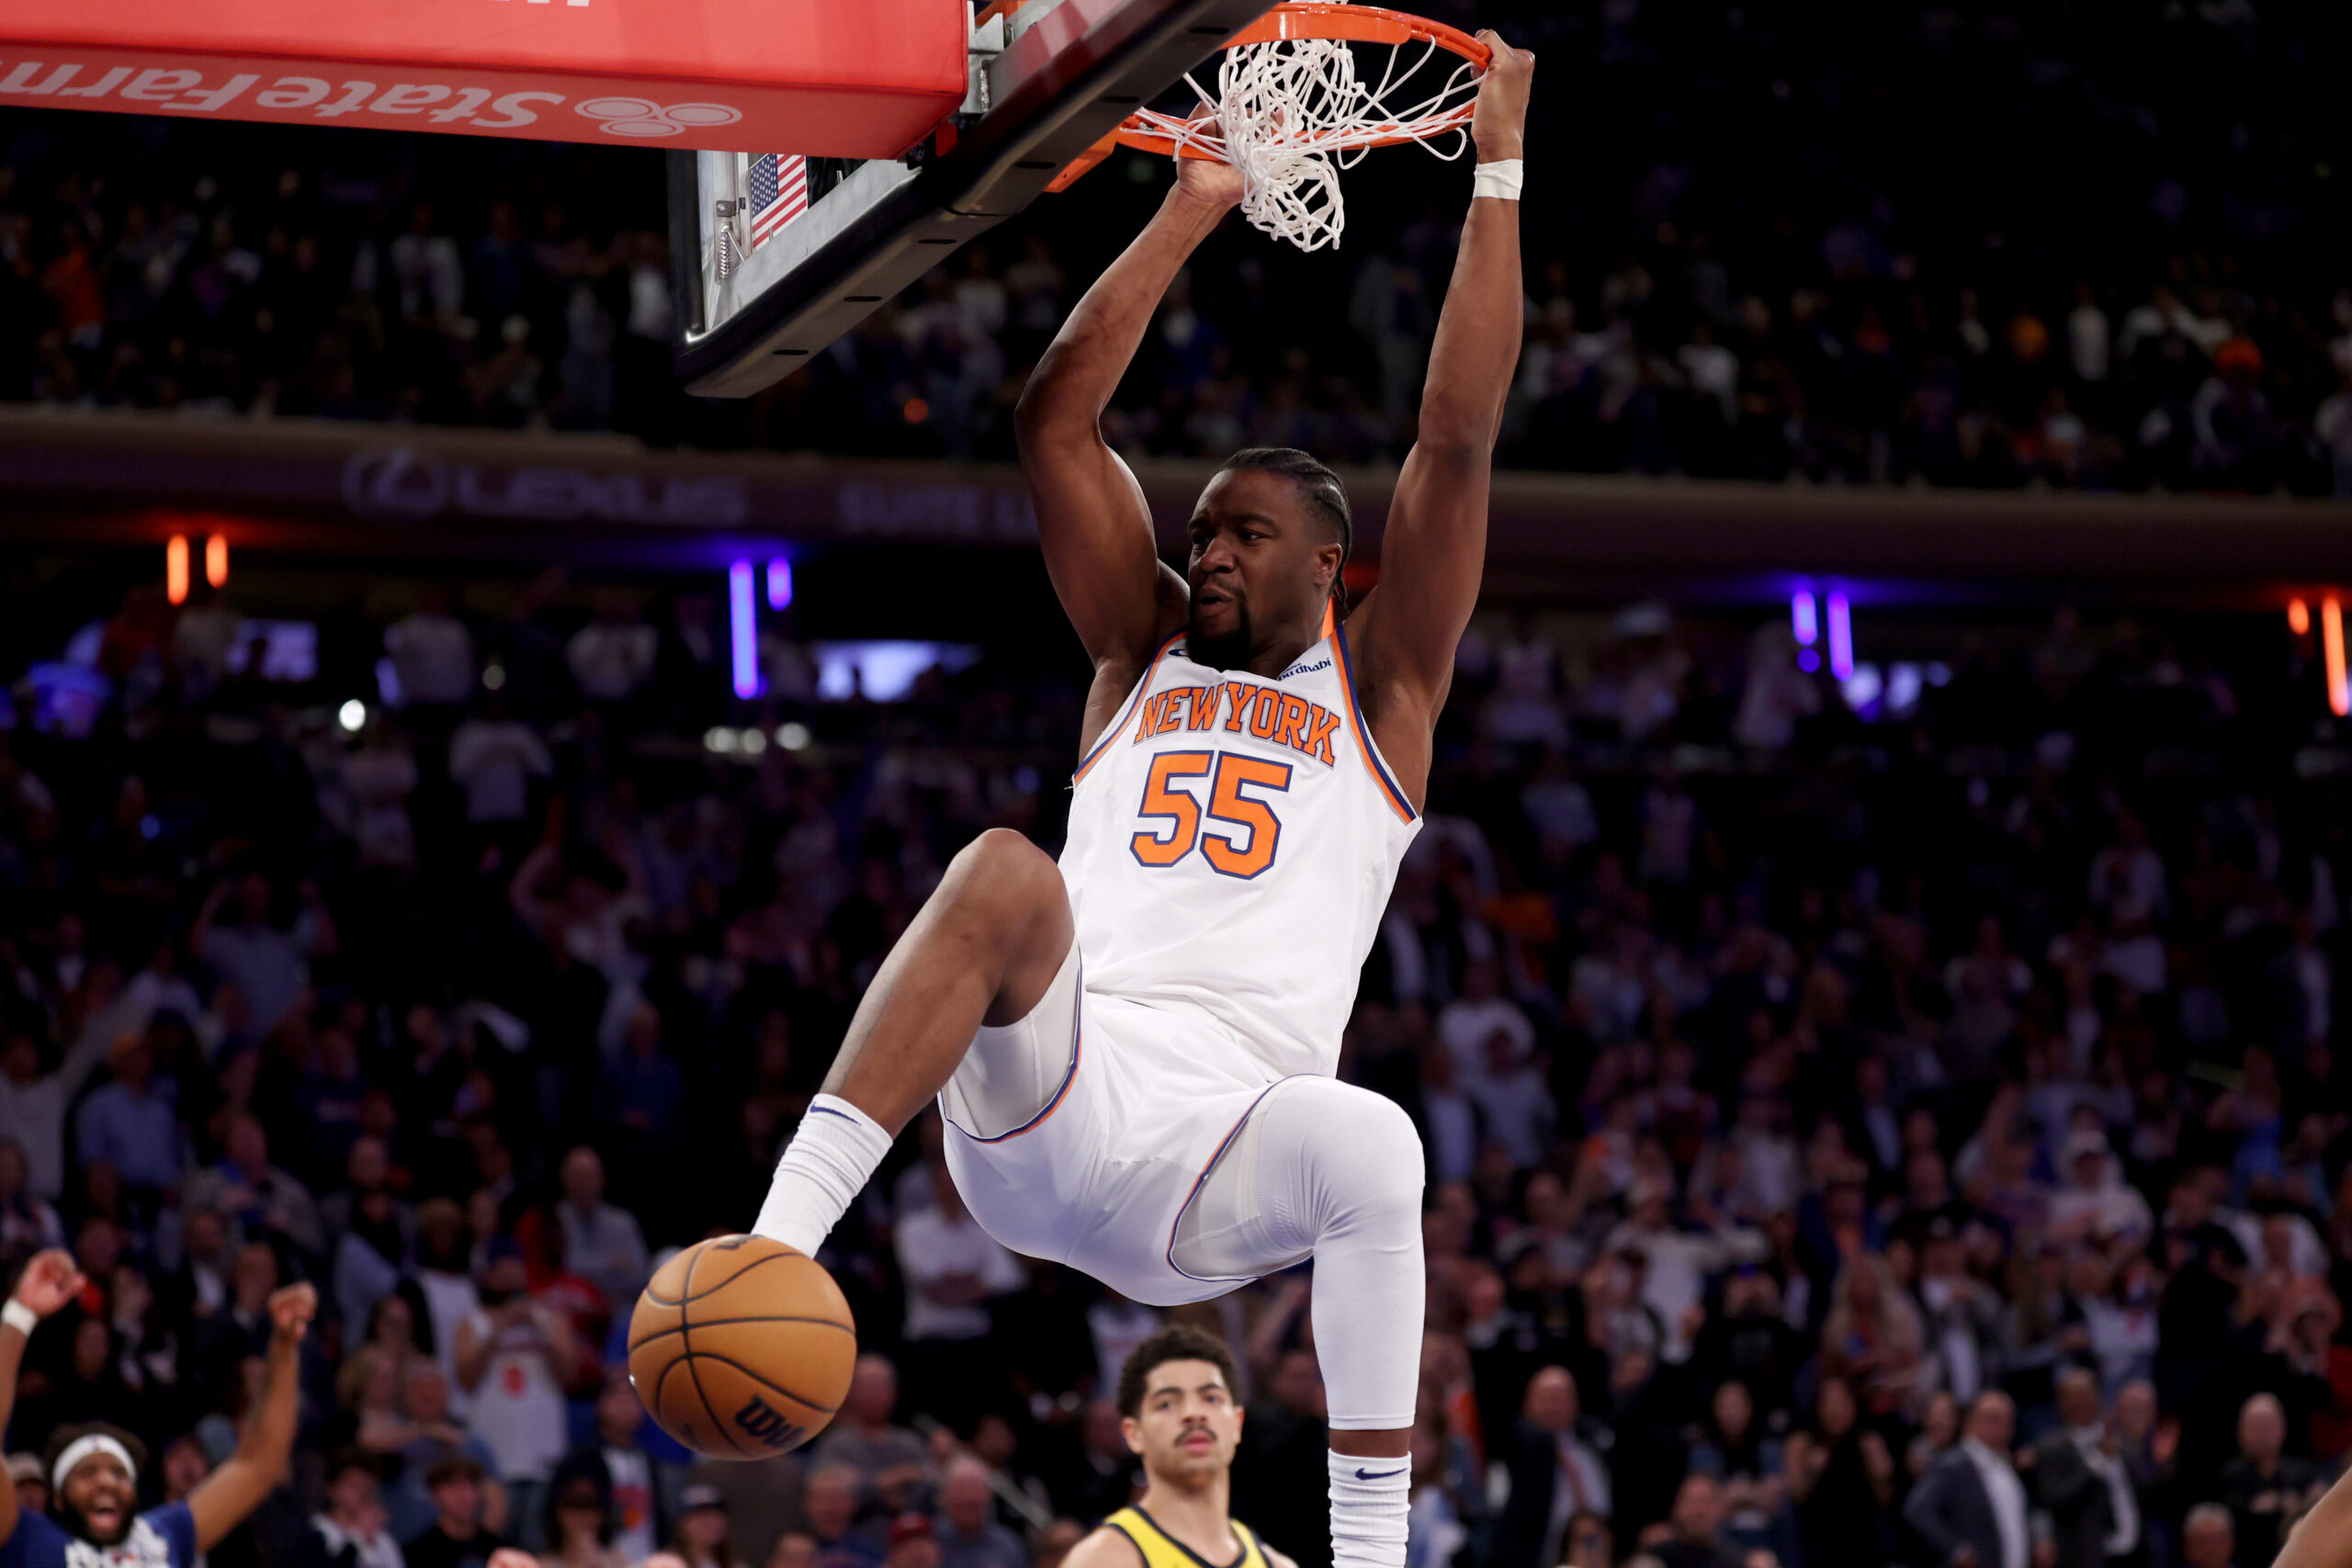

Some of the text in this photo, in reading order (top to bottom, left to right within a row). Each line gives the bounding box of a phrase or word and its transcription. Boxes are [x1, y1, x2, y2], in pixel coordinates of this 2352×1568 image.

[1295, 657, 1331, 673] dhabi
[1132, 680, 1340, 770] NEW YORK
[1129, 750, 1294, 881] 55
